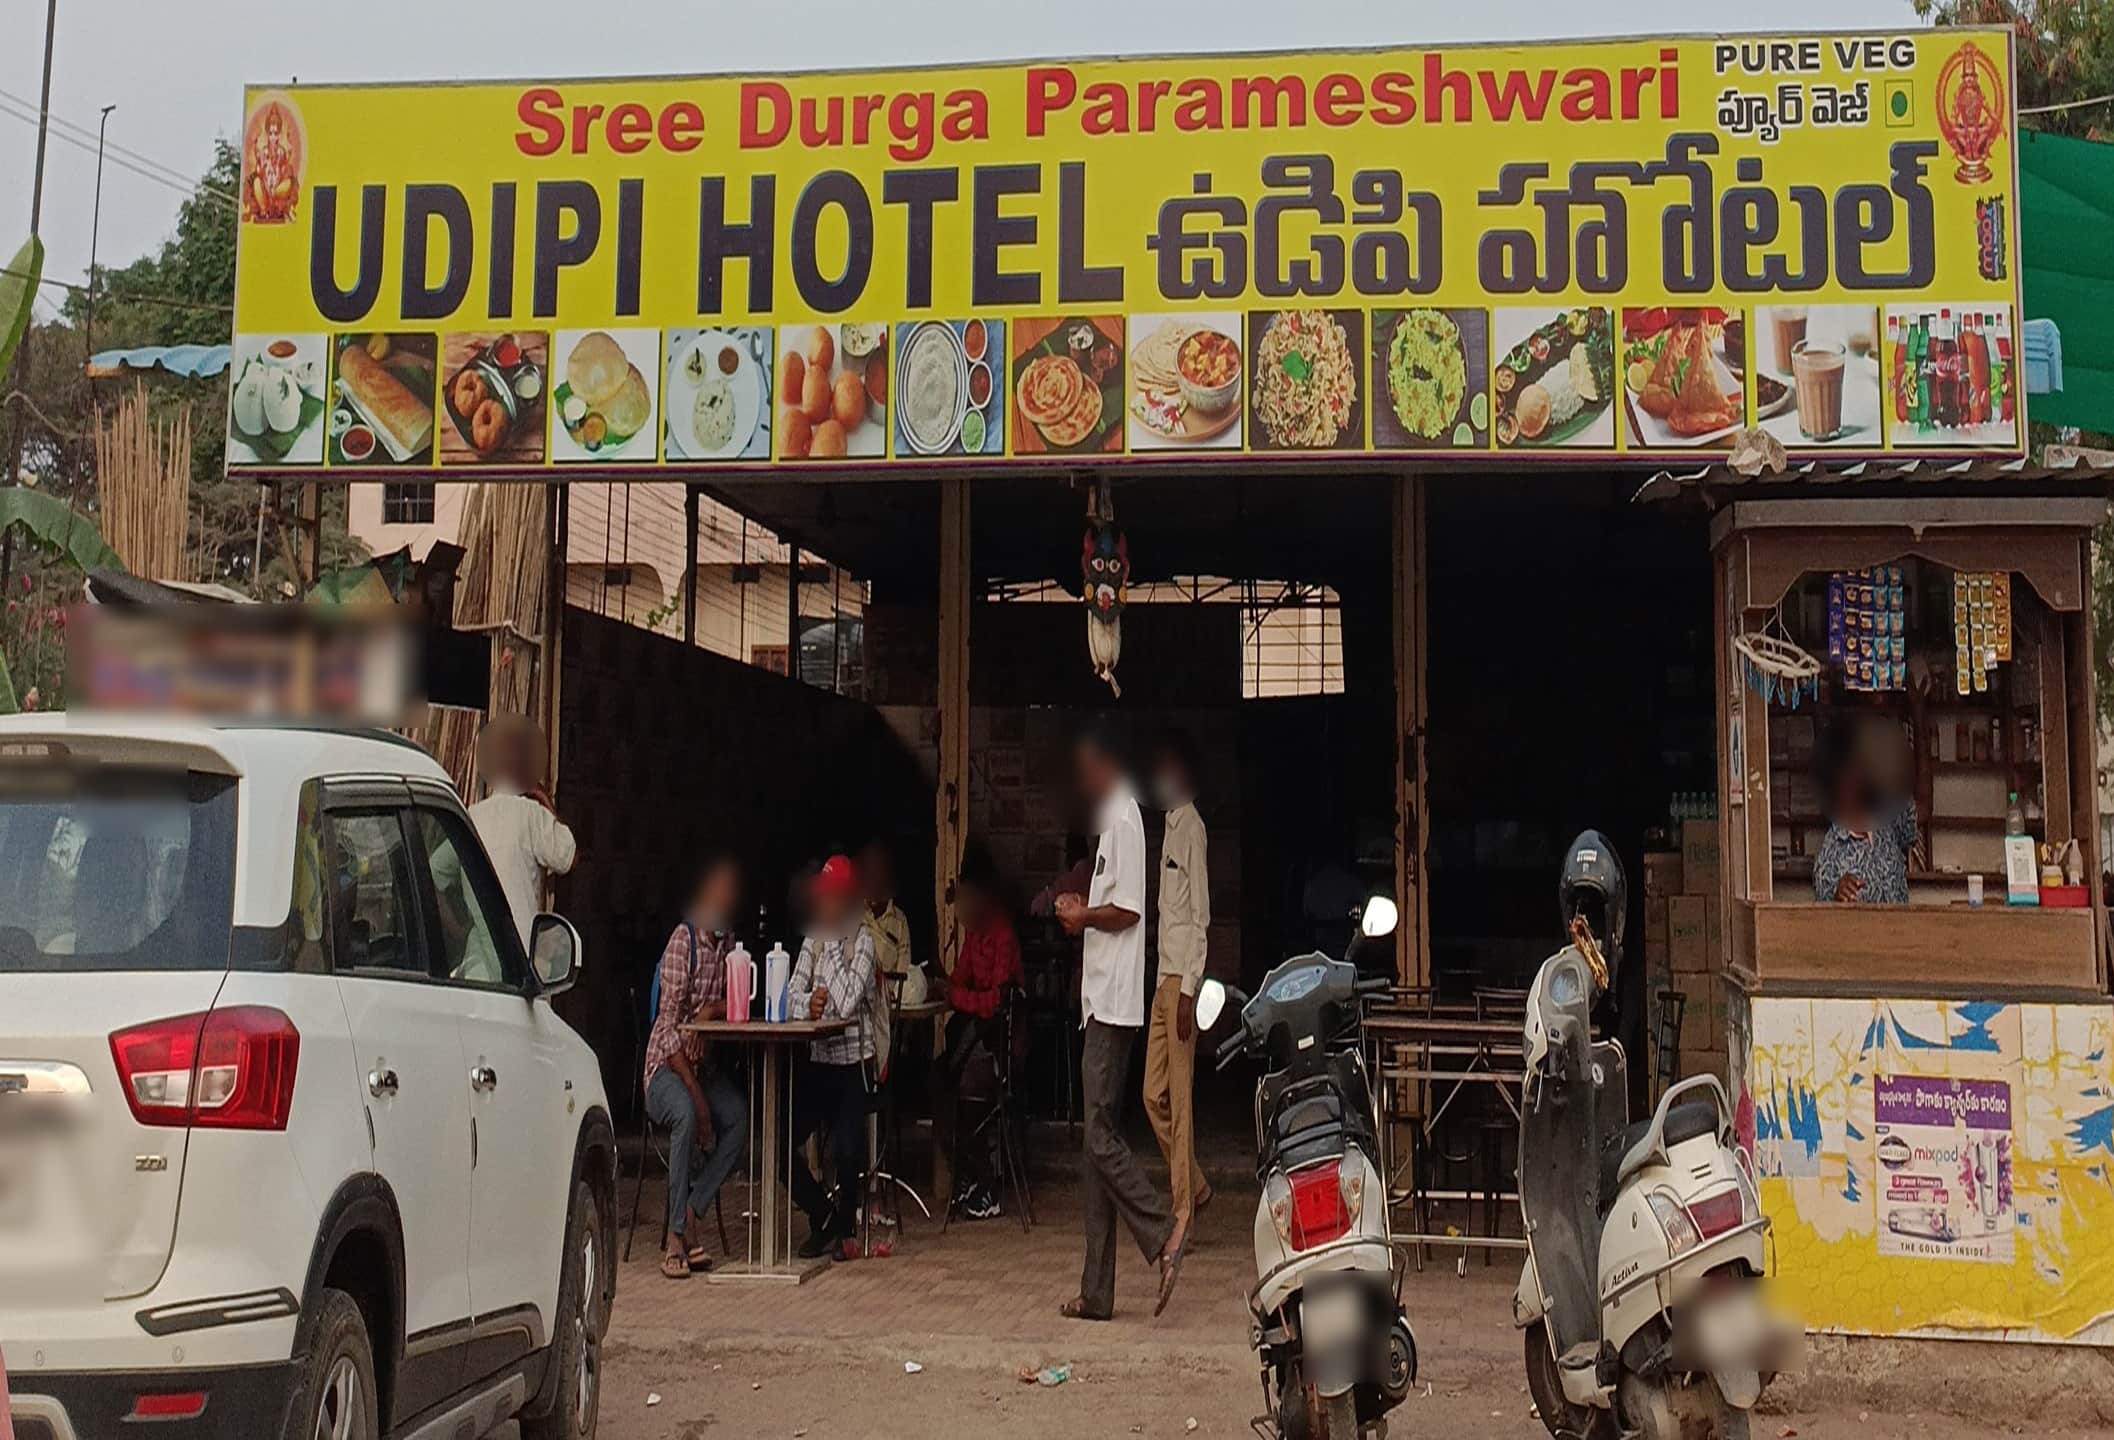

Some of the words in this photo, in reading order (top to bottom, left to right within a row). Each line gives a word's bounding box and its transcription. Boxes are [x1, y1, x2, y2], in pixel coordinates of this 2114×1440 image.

[1715, 43, 1820, 72] PURE
[1834, 39, 1915, 69] VEG
[515, 88, 705, 156] Sree
[739, 81, 989, 162] Durga
[1026, 48, 1679, 137] Parameshwari
[1811, 82, 1870, 125] వెజ్
[1146, 154, 1443, 300] ఉడిపి
[1477, 132, 1939, 294] హోటల్
[310, 178, 644, 322] UDIPI
[697, 161, 1124, 314] HOTEL
[1914, 1144, 1959, 1165] mixpod
[1900, 1241, 1914, 1252] THE
[1919, 1243, 1941, 1254] GOLD
